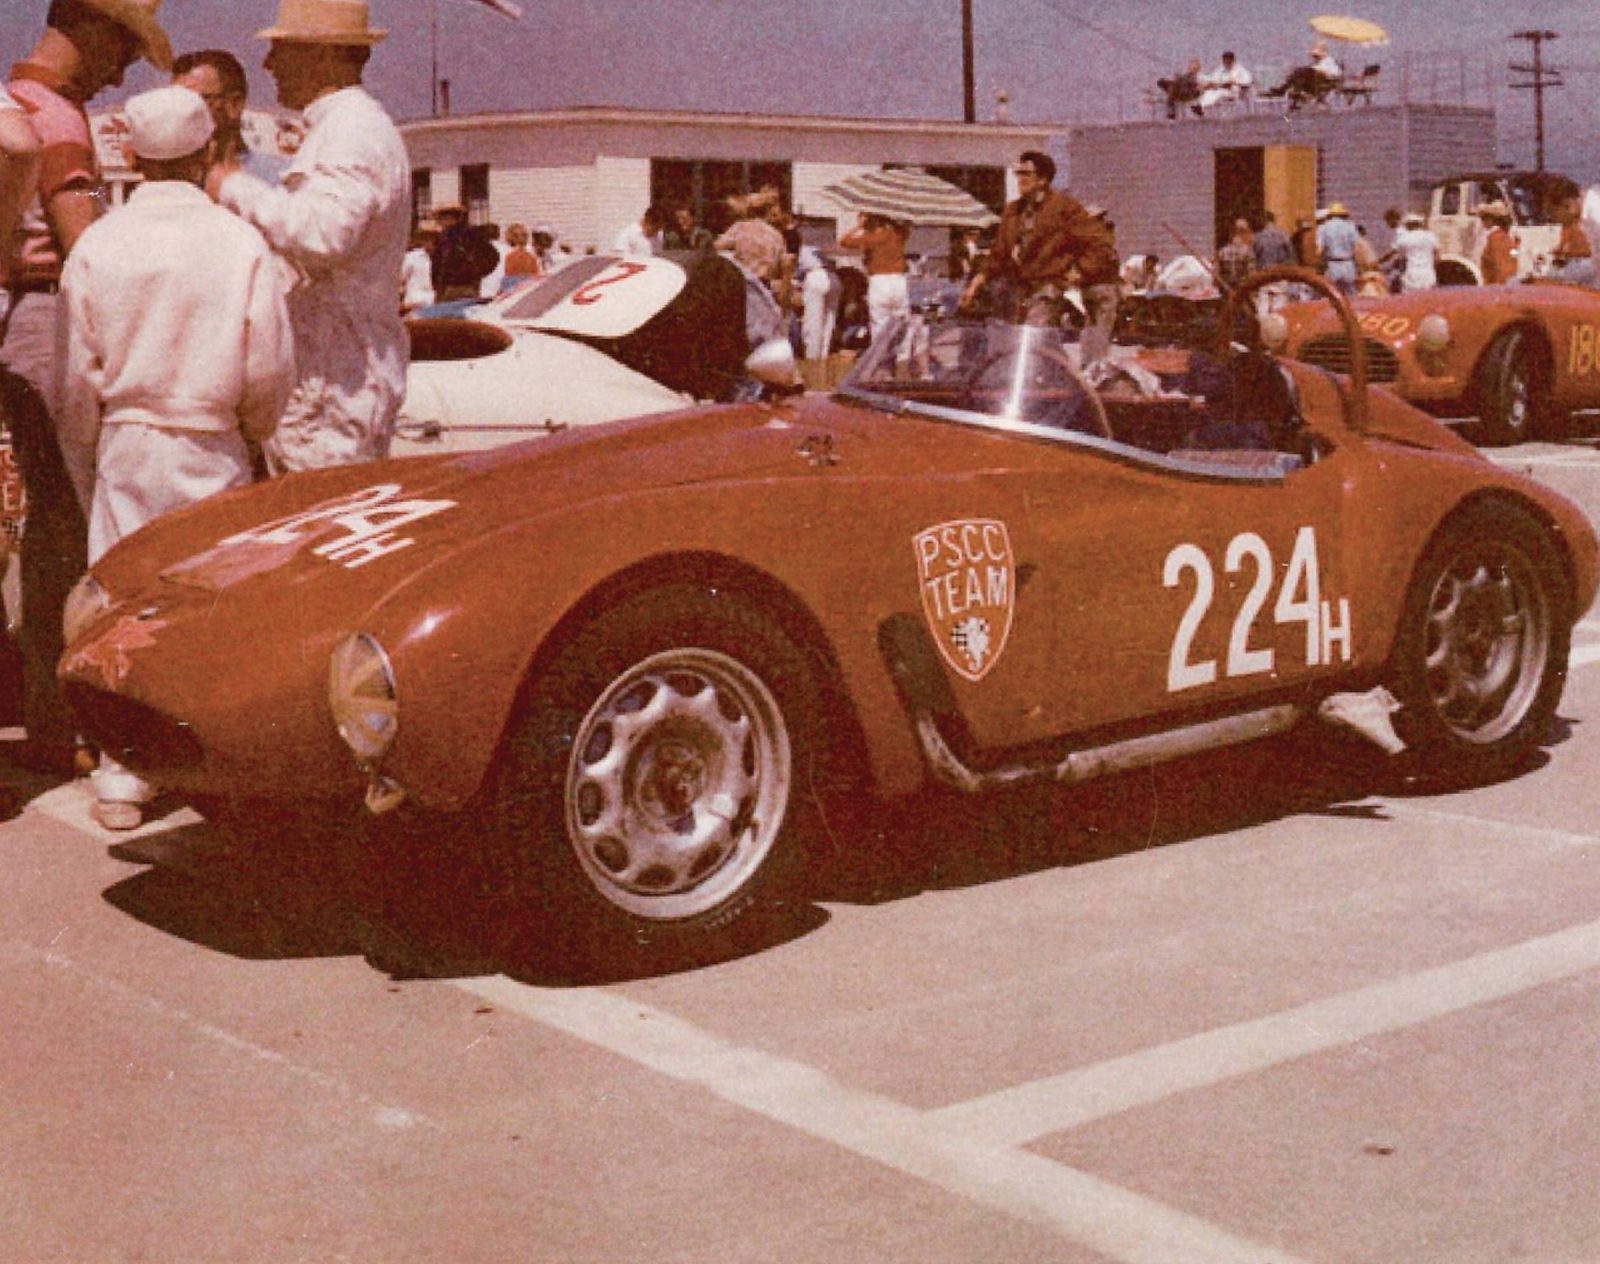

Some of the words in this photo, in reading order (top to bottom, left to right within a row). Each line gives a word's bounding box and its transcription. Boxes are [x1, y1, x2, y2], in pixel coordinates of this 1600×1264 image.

[1355, 310, 1410, 336] 80
[919, 524, 1006, 578] PSCC
[926, 566, 1008, 620] TEAM
[1163, 526, 1350, 692] 224H
